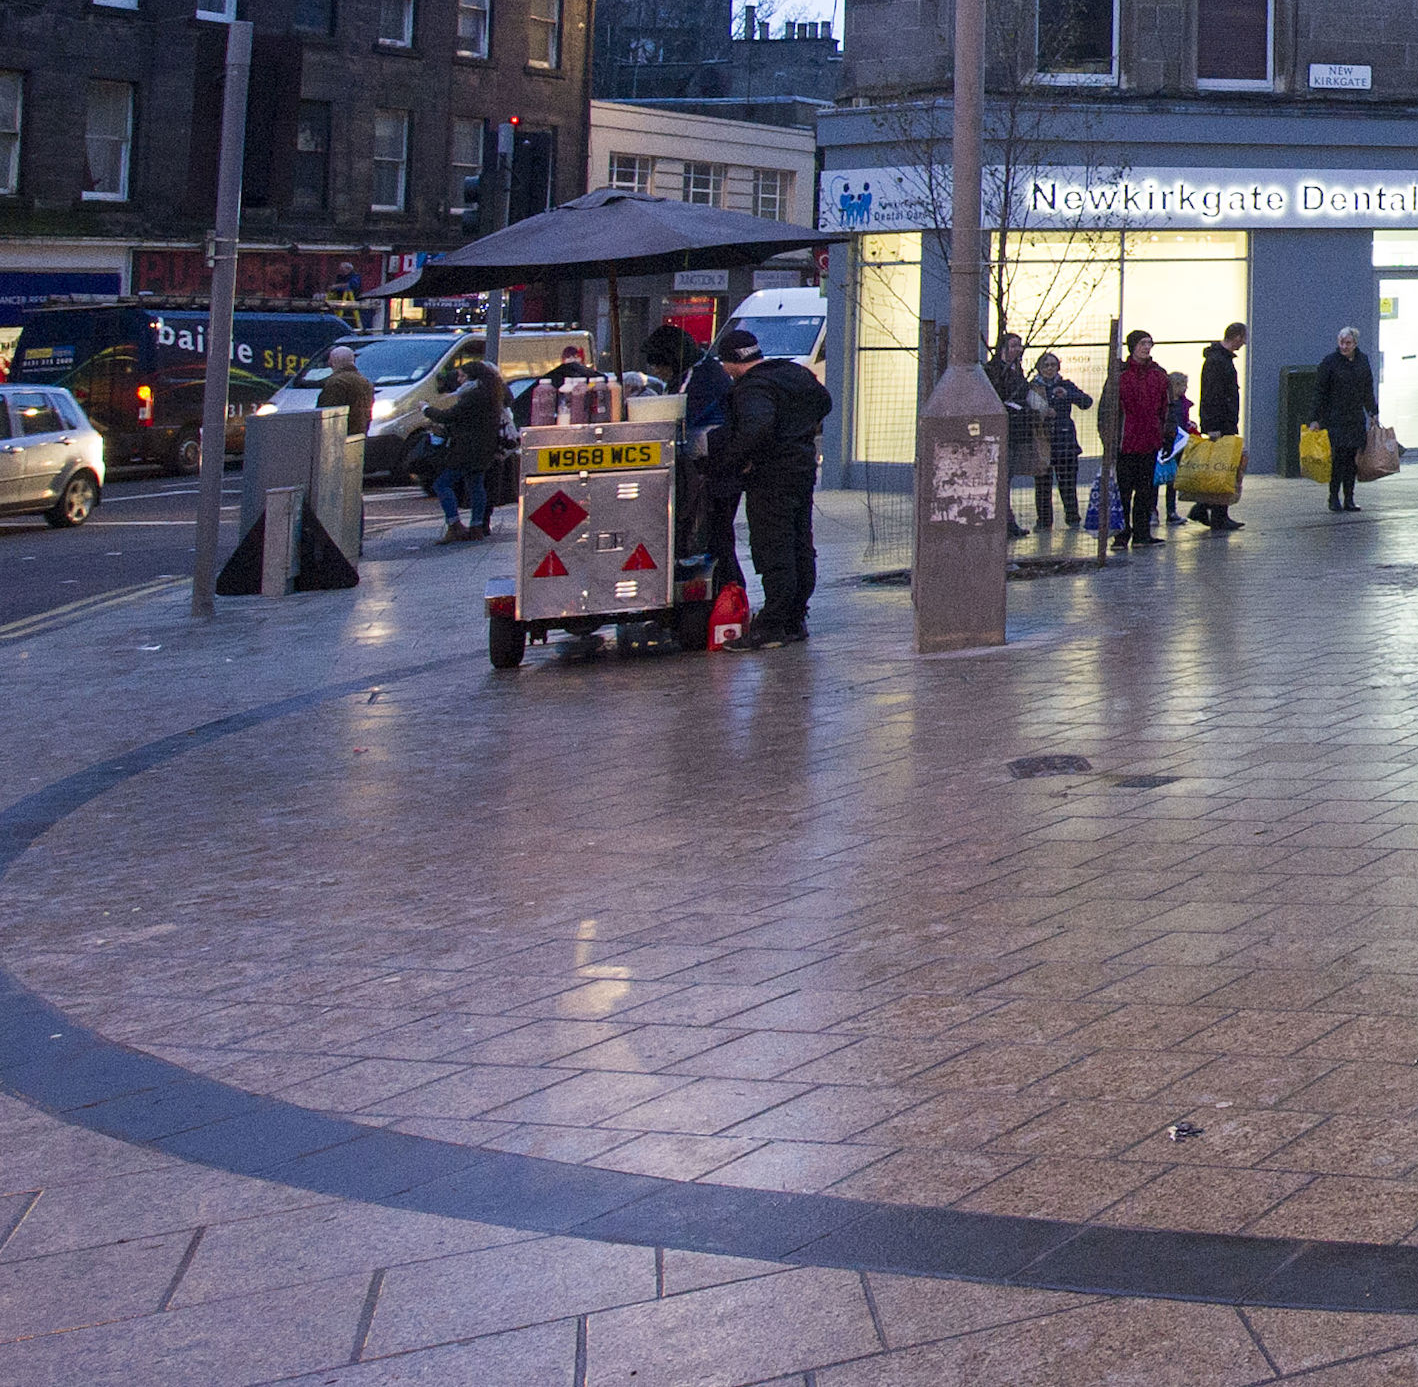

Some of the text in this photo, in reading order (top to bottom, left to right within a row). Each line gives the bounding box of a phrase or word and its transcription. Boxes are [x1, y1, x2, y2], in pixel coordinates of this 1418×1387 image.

[1328, 65, 1354, 76] NEW
[1313, 75, 1369, 88] KIRKGATE
[1032, 182, 1285, 218] Newkirkgate
[1303, 185, 1418, 213] Dental
[549, 445, 652, 468] W968 WCS
